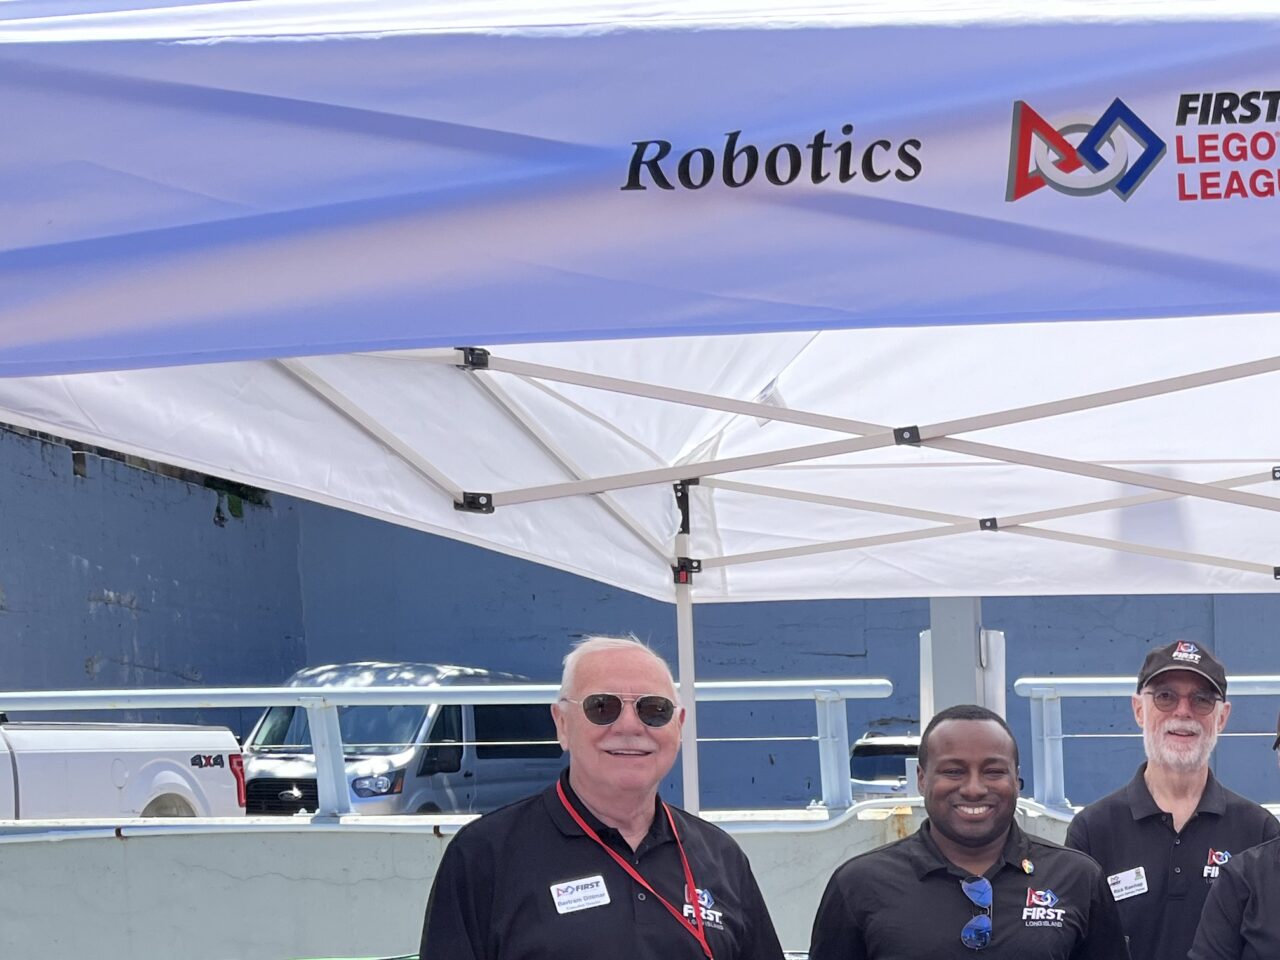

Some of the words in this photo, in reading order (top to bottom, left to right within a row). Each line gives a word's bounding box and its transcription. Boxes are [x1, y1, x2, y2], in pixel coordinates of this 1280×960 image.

[620, 124, 922, 191] Robotics
[1178, 131, 1276, 163] LEGO
[576, 882, 600, 892] FIRST
[1022, 907, 1066, 921] FIRST
